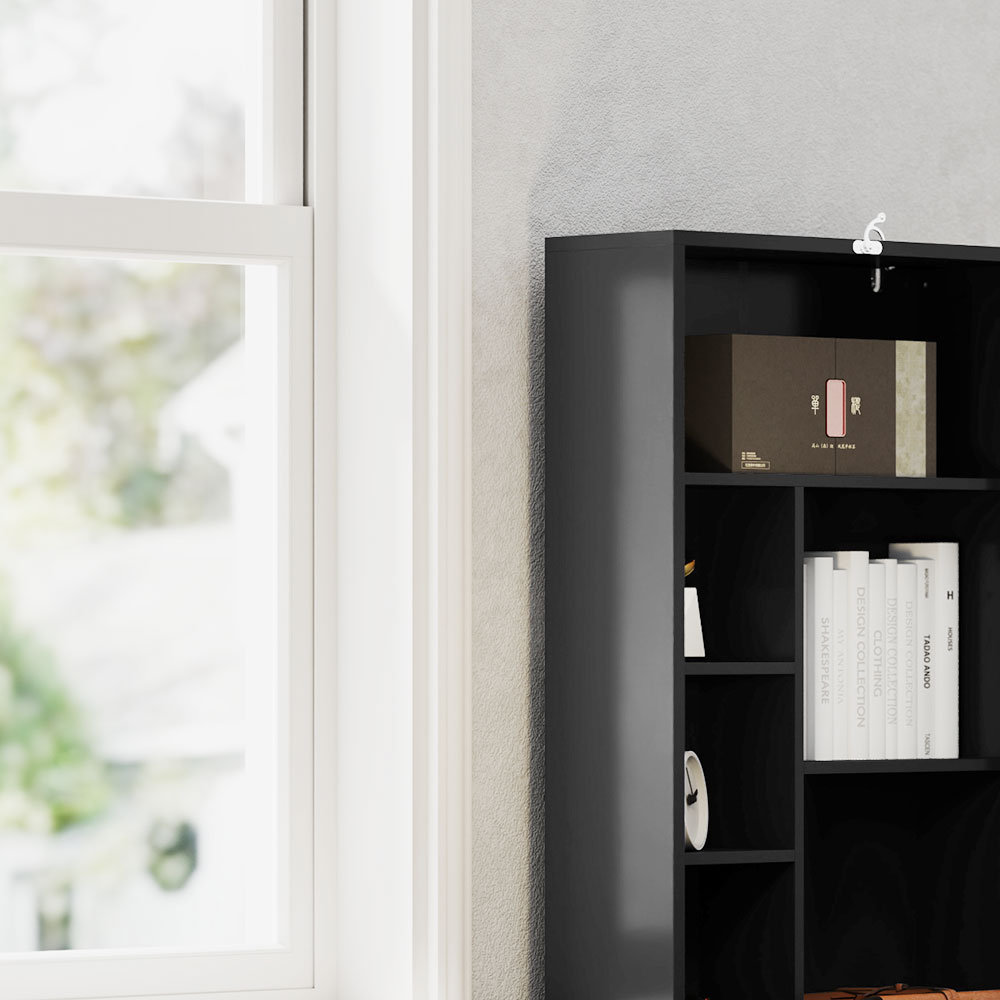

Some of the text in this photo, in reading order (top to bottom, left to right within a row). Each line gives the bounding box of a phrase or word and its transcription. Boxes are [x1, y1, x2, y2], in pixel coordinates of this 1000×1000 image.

[820, 617, 830, 704] SHAKESPEARE
[856, 586, 866, 728] DESIGN COLLECTION
[873, 630, 882, 697] CLOTHING
[887, 597, 897, 725] DESIGN COLLECTION
[905, 601, 913, 727] DESIGN COLLECTION
[923, 634, 931, 689] TADAO ANDO
